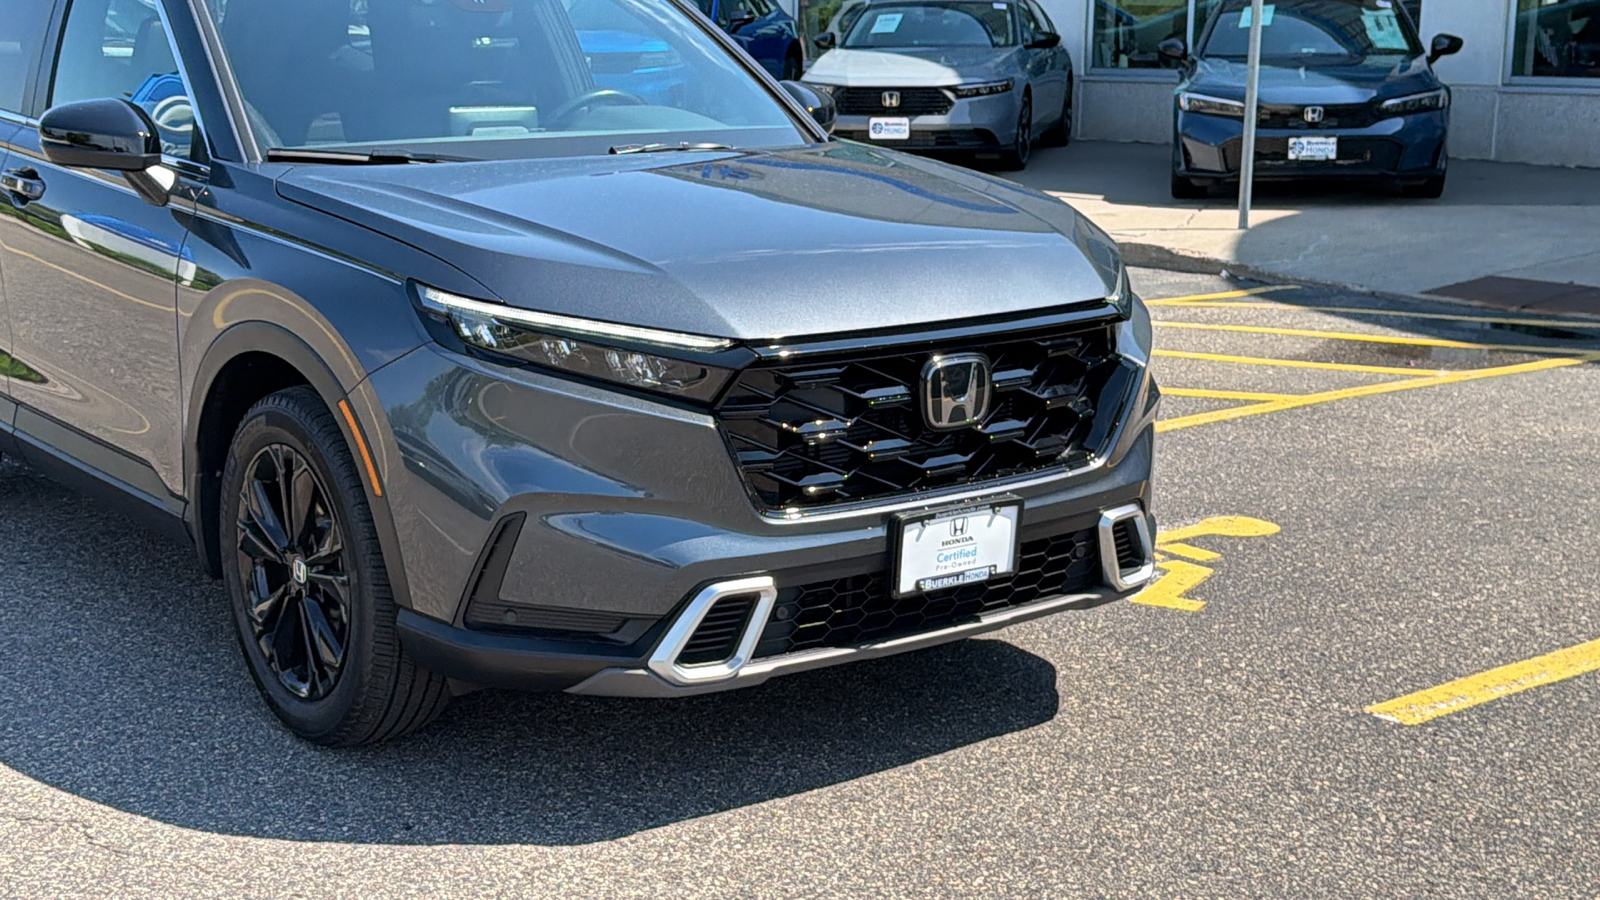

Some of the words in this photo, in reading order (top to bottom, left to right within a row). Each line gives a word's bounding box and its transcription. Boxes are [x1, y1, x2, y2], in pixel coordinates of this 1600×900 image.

[941, 535, 974, 547] HONDA
[936, 546, 977, 563] Certified
[936, 558, 977, 571] Pre-Owned
[925, 575, 964, 590] BUERKLE
[964, 570, 987, 581] HONDA
